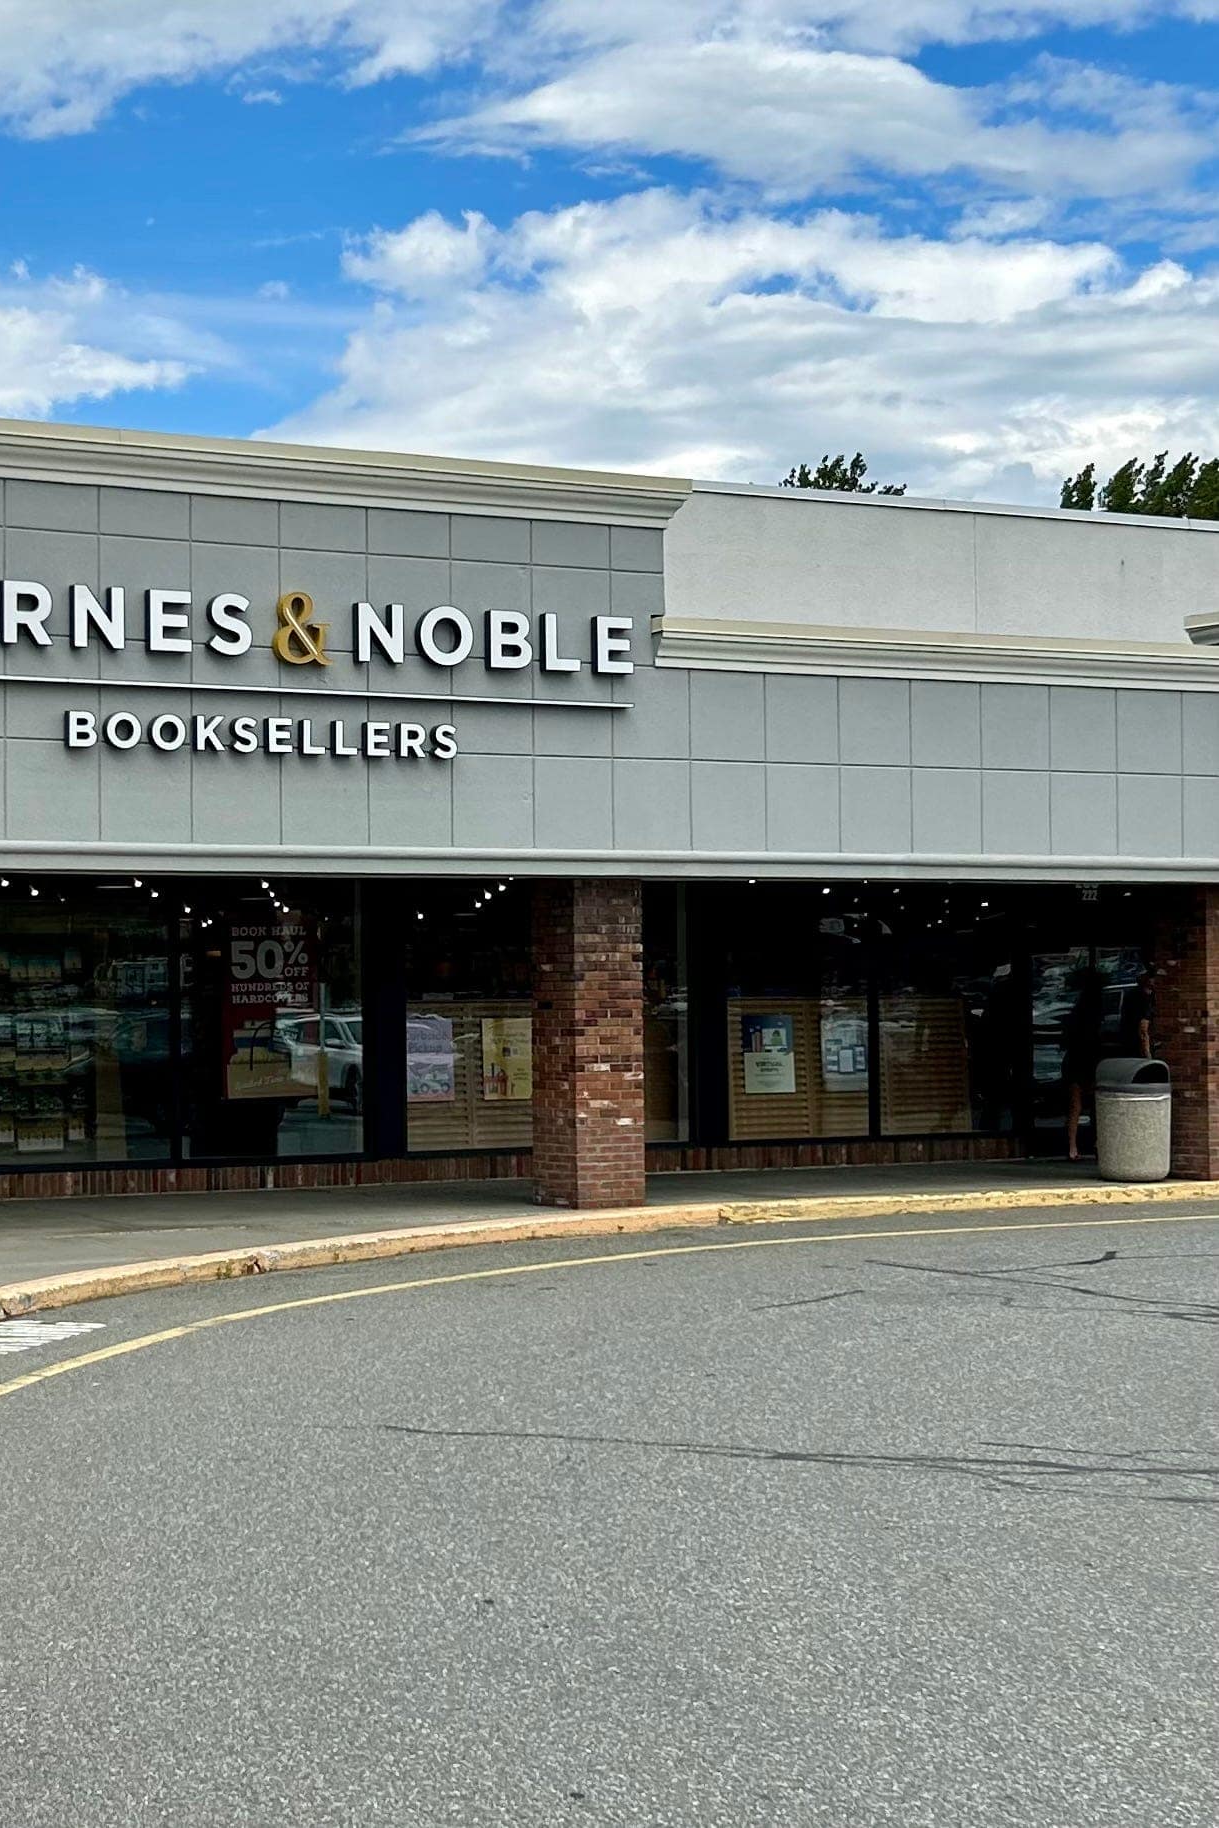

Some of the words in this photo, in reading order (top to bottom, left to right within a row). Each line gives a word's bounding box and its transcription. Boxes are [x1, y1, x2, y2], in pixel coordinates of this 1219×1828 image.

[272, 591, 333, 666] &
[352, 601, 634, 676] NOBLE
[64, 709, 459, 761] BOOKSELLERS
[231, 926, 267, 937] BOOK
[271, 925, 307, 936] HAUL
[230, 939, 309, 980] 50%
[284, 966, 310, 977] OFF
[230, 981, 294, 993] HUNDREDS
